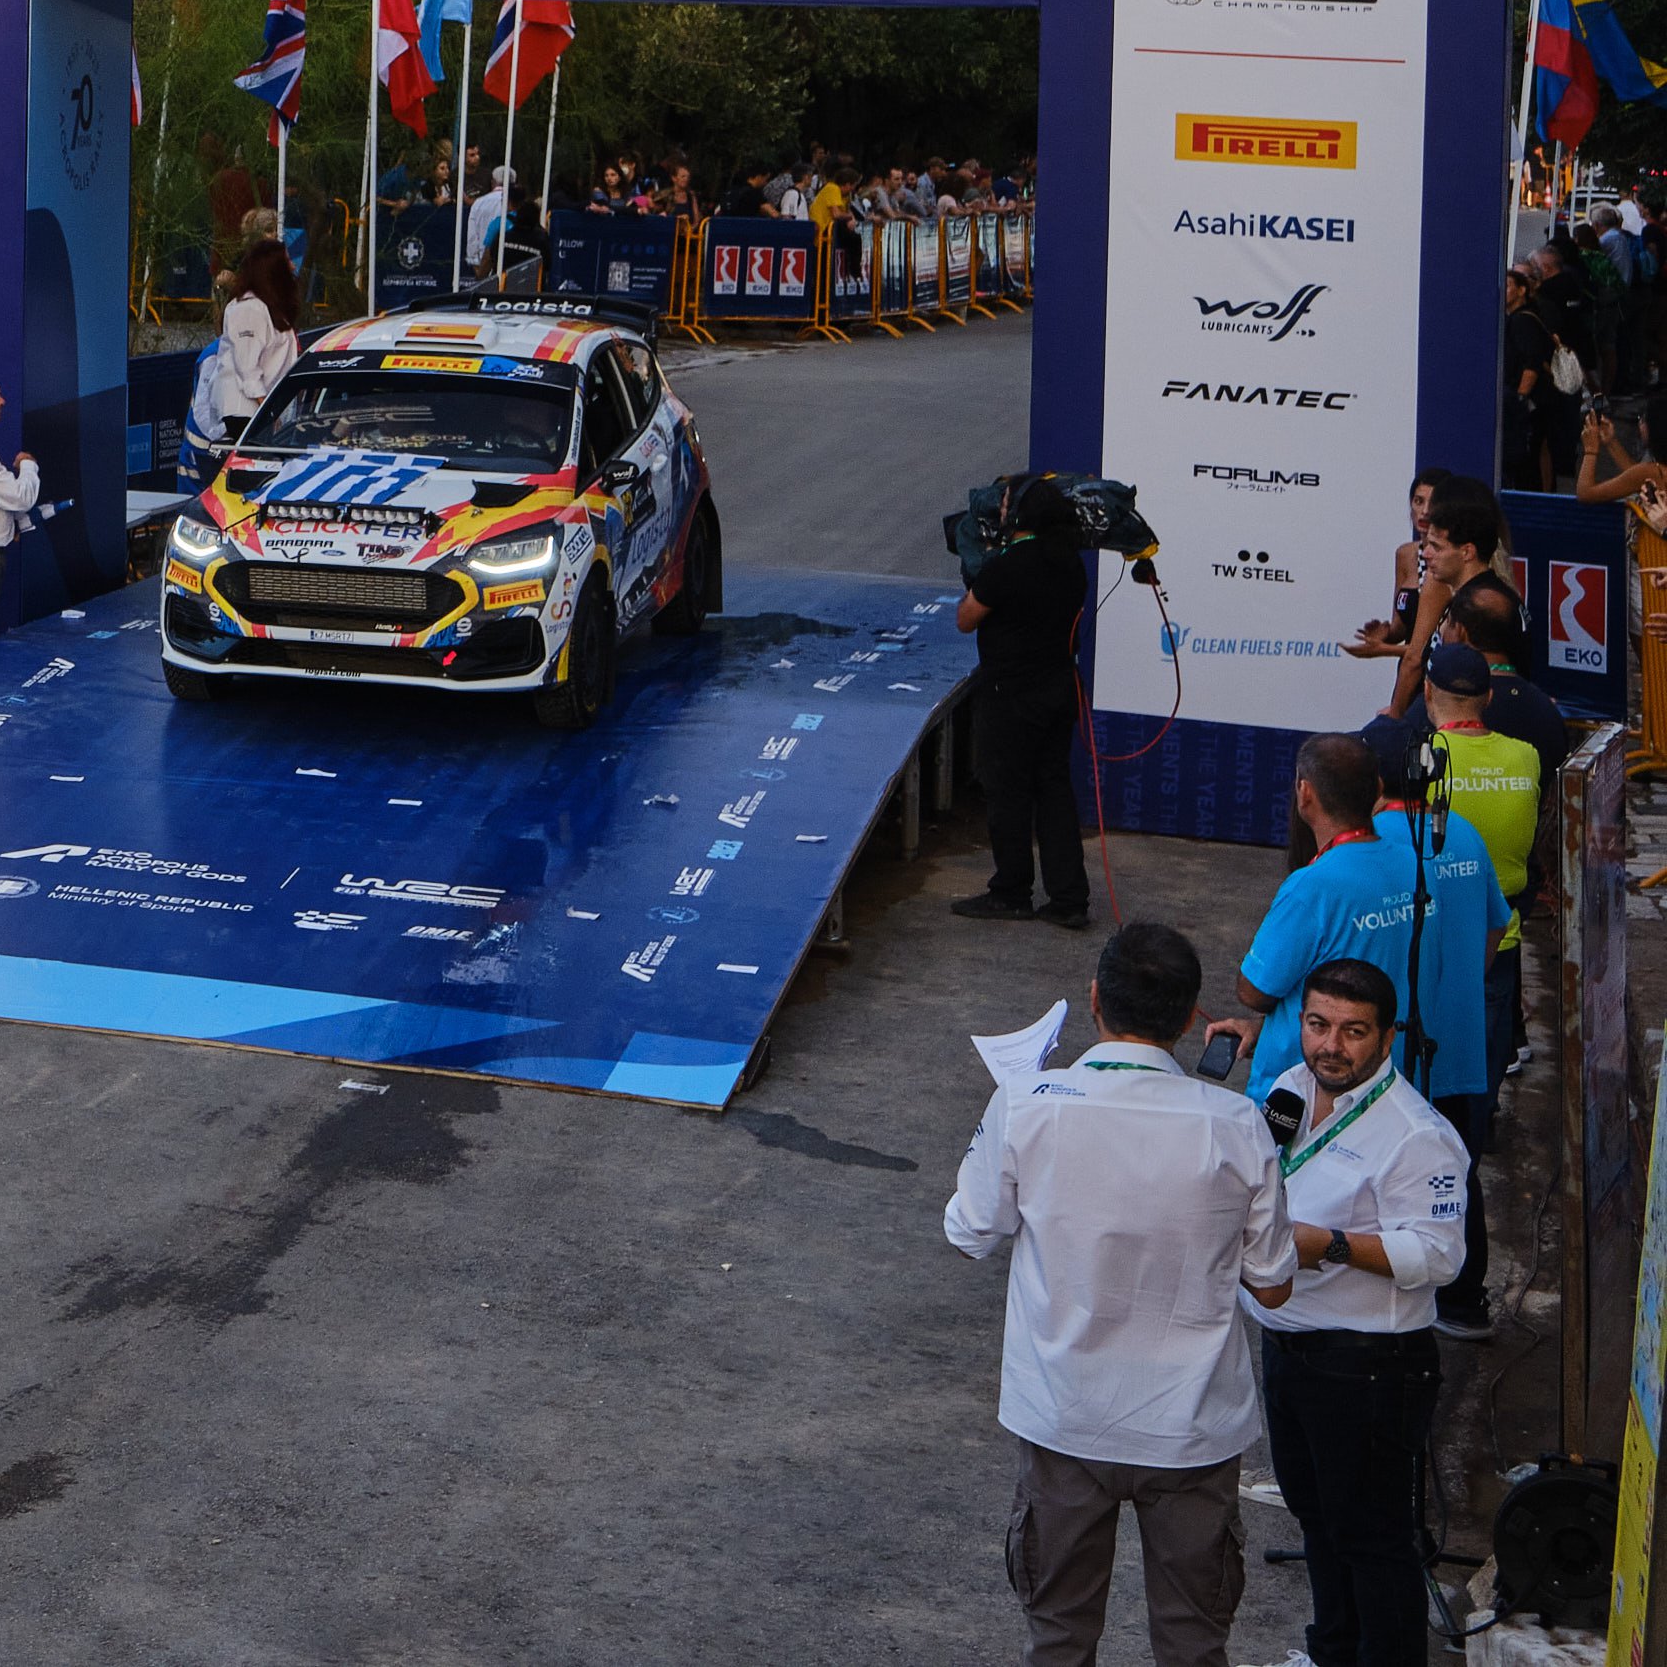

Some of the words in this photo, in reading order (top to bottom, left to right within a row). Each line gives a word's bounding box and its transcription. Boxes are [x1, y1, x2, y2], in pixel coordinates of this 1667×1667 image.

[1214, 0, 1373, 12] CHAMPIONSHIP
[1192, 122, 1341, 160] PIRELLI
[1201, 321, 1273, 336] LUBRICANTS
[391, 358, 474, 370] PIRELLI
[1162, 380, 1351, 411] FANATEC
[1193, 464, 1320, 487] FORUM8
[265, 539, 334, 548] BARBARA
[169, 564, 198, 588] PIRELLI
[1211, 564, 1238, 578] TW
[1242, 567, 1295, 583] STEEL
[489, 584, 539, 605] PIRELLI
[1192, 637, 1236, 654] CLEAN
[1239, 639, 1283, 656] FUELS
[1286, 641, 1312, 657] FOR
[1315, 642, 1342, 658] ALL
[1565, 648, 1602, 667] EKO
[1471, 767, 1504, 776] PROUD
[91, 854, 210, 872] ACROPOLIS
[97, 848, 153, 858] EKO
[85, 860, 149, 872] RALLY
[153, 866, 183, 876] OF
[186, 870, 248, 883] GODS
[340, 873, 506, 901] WRC
[48, 892, 115, 906] Ministry
[118, 899, 138, 907] of
[140, 902, 195, 914] Sports
[55, 884, 151, 901] HELLENIC
[155, 895, 255, 912] REPUBLIC
[1353, 900, 1437, 932] VOLUNTER
[1432, 1202, 1461, 1217] OMAE
